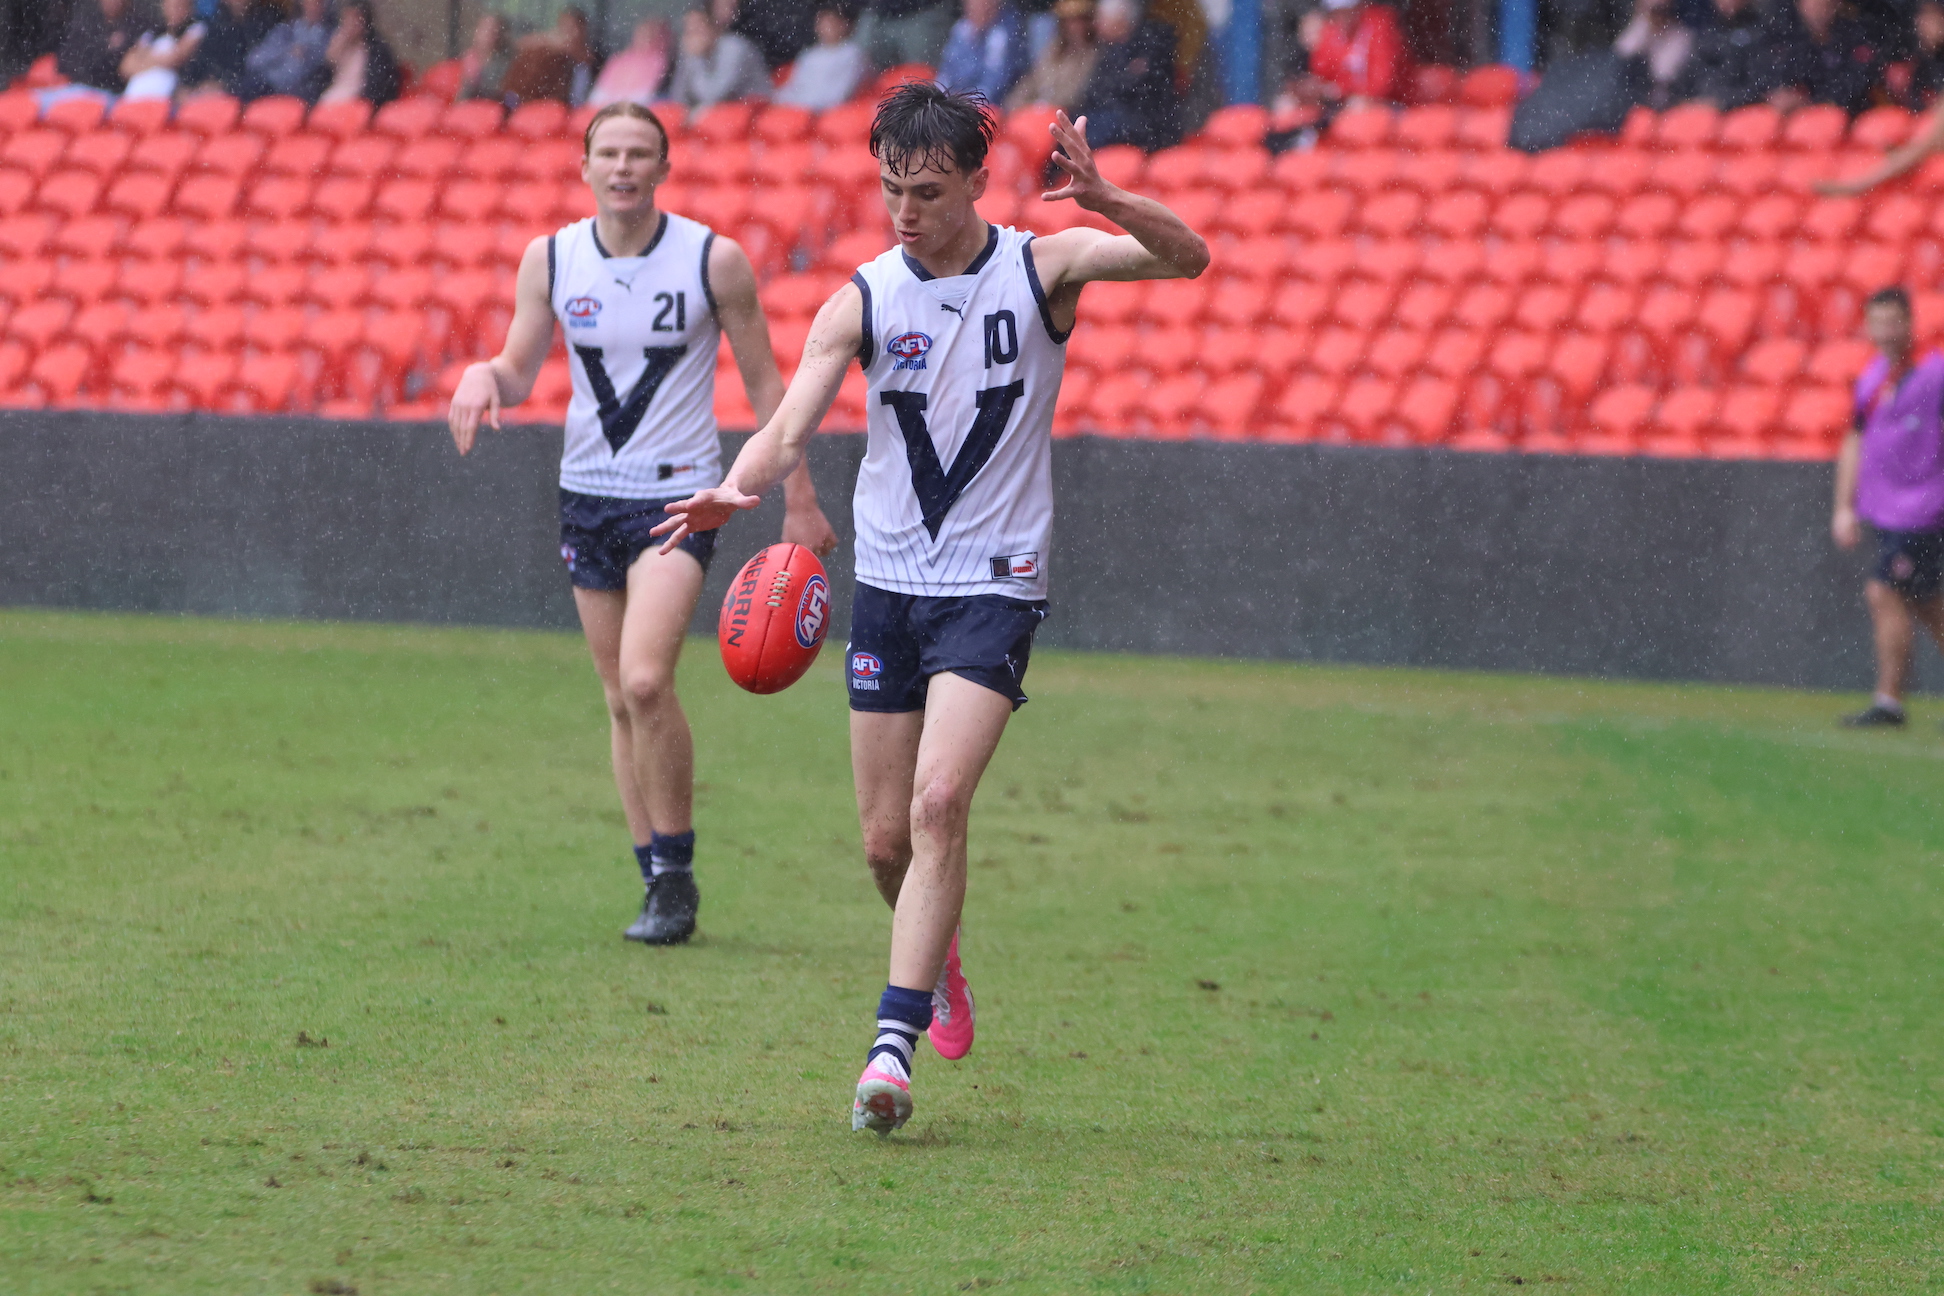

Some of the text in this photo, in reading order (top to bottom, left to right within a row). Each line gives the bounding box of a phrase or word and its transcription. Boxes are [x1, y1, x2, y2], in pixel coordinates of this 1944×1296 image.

[568, 299, 600, 314] AFL
[652, 291, 686, 332] 21
[890, 336, 929, 354] AFL
[984, 309, 1018, 369] 10
[573, 344, 688, 459] V
[880, 378, 1025, 544] V
[727, 548, 769, 648] SHERRIN
[801, 584, 828, 645] AFL
[852, 657, 881, 672] AFL
[852, 677, 880, 691] VICTORIA
